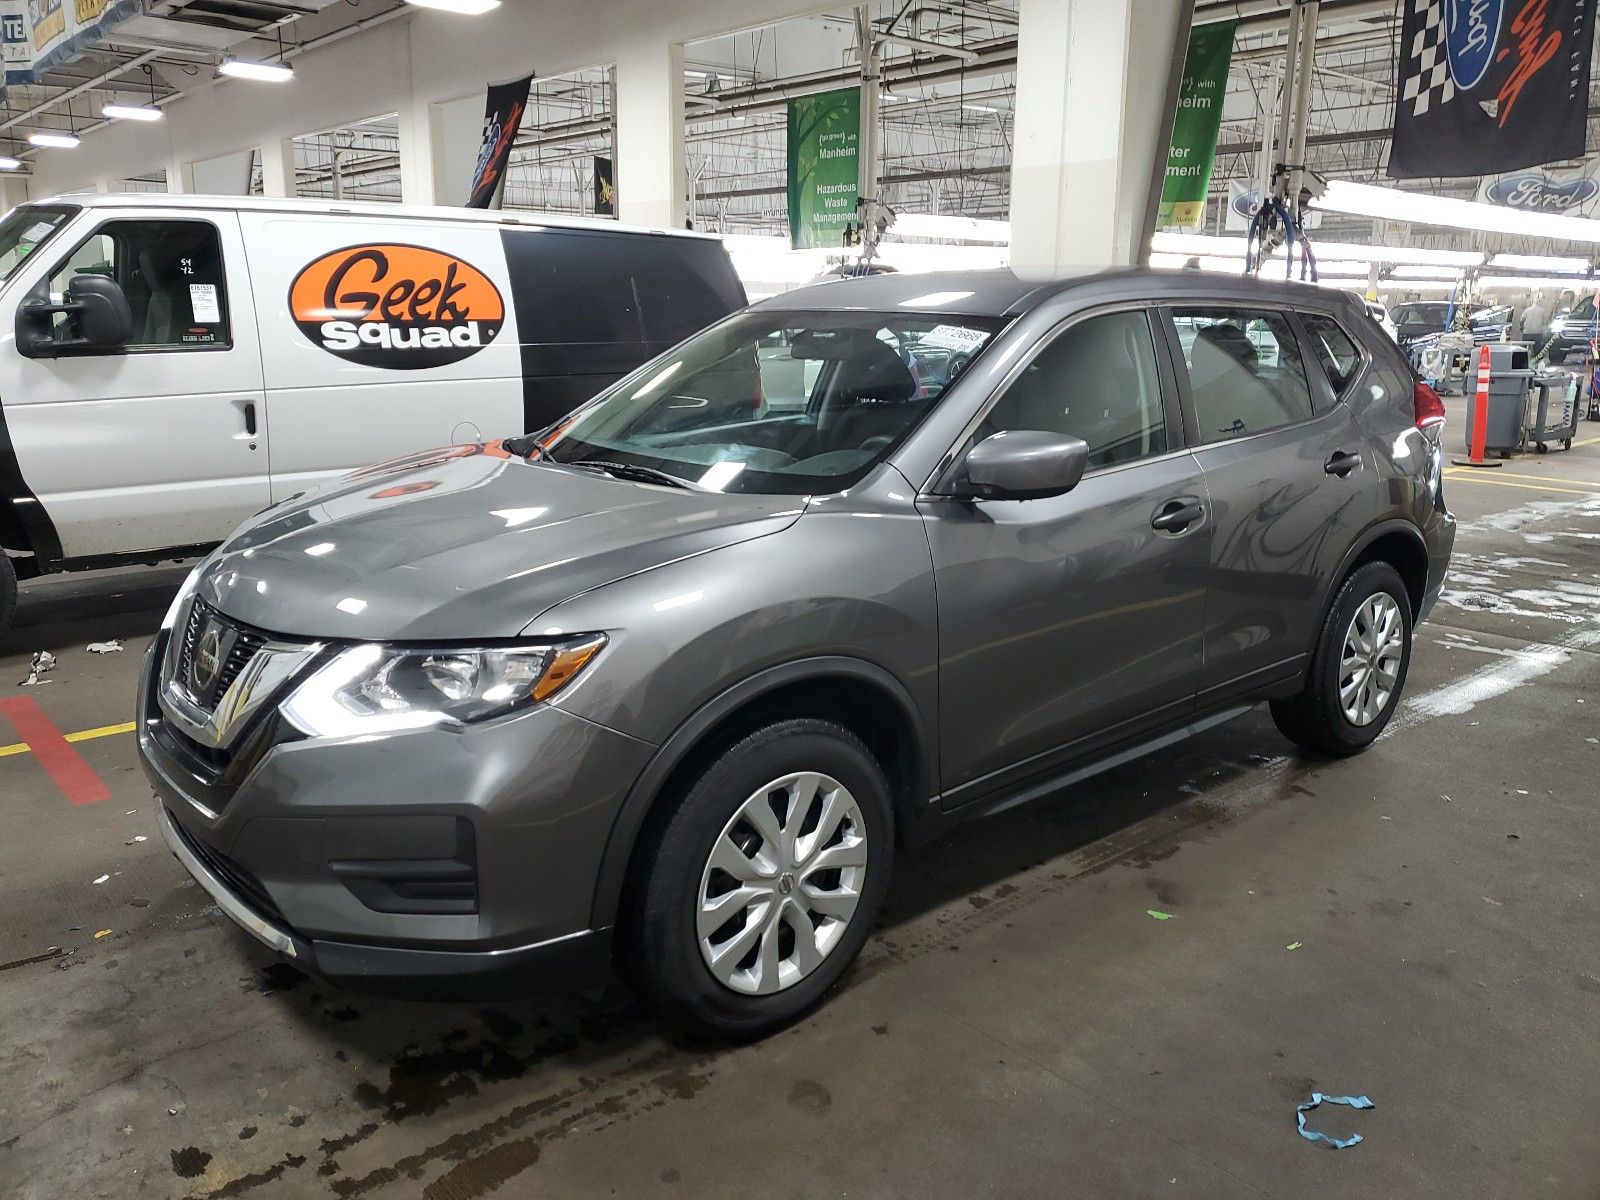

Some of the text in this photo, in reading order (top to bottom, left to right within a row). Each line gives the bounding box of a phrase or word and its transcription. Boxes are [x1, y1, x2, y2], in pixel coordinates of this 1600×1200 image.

[1197, 80, 1216, 88] with
[819, 146, 856, 160] Manheim
[1170, 145, 1190, 158] ter
[1166, 164, 1200, 176] ment
[816, 182, 857, 194] Hazardous
[1507, 179, 1580, 208] Ford
[824, 197, 848, 208] Waste
[763, 208, 788, 217] HYUNDA
[324, 249, 470, 321] Geek
[320, 320, 481, 350] Squad
